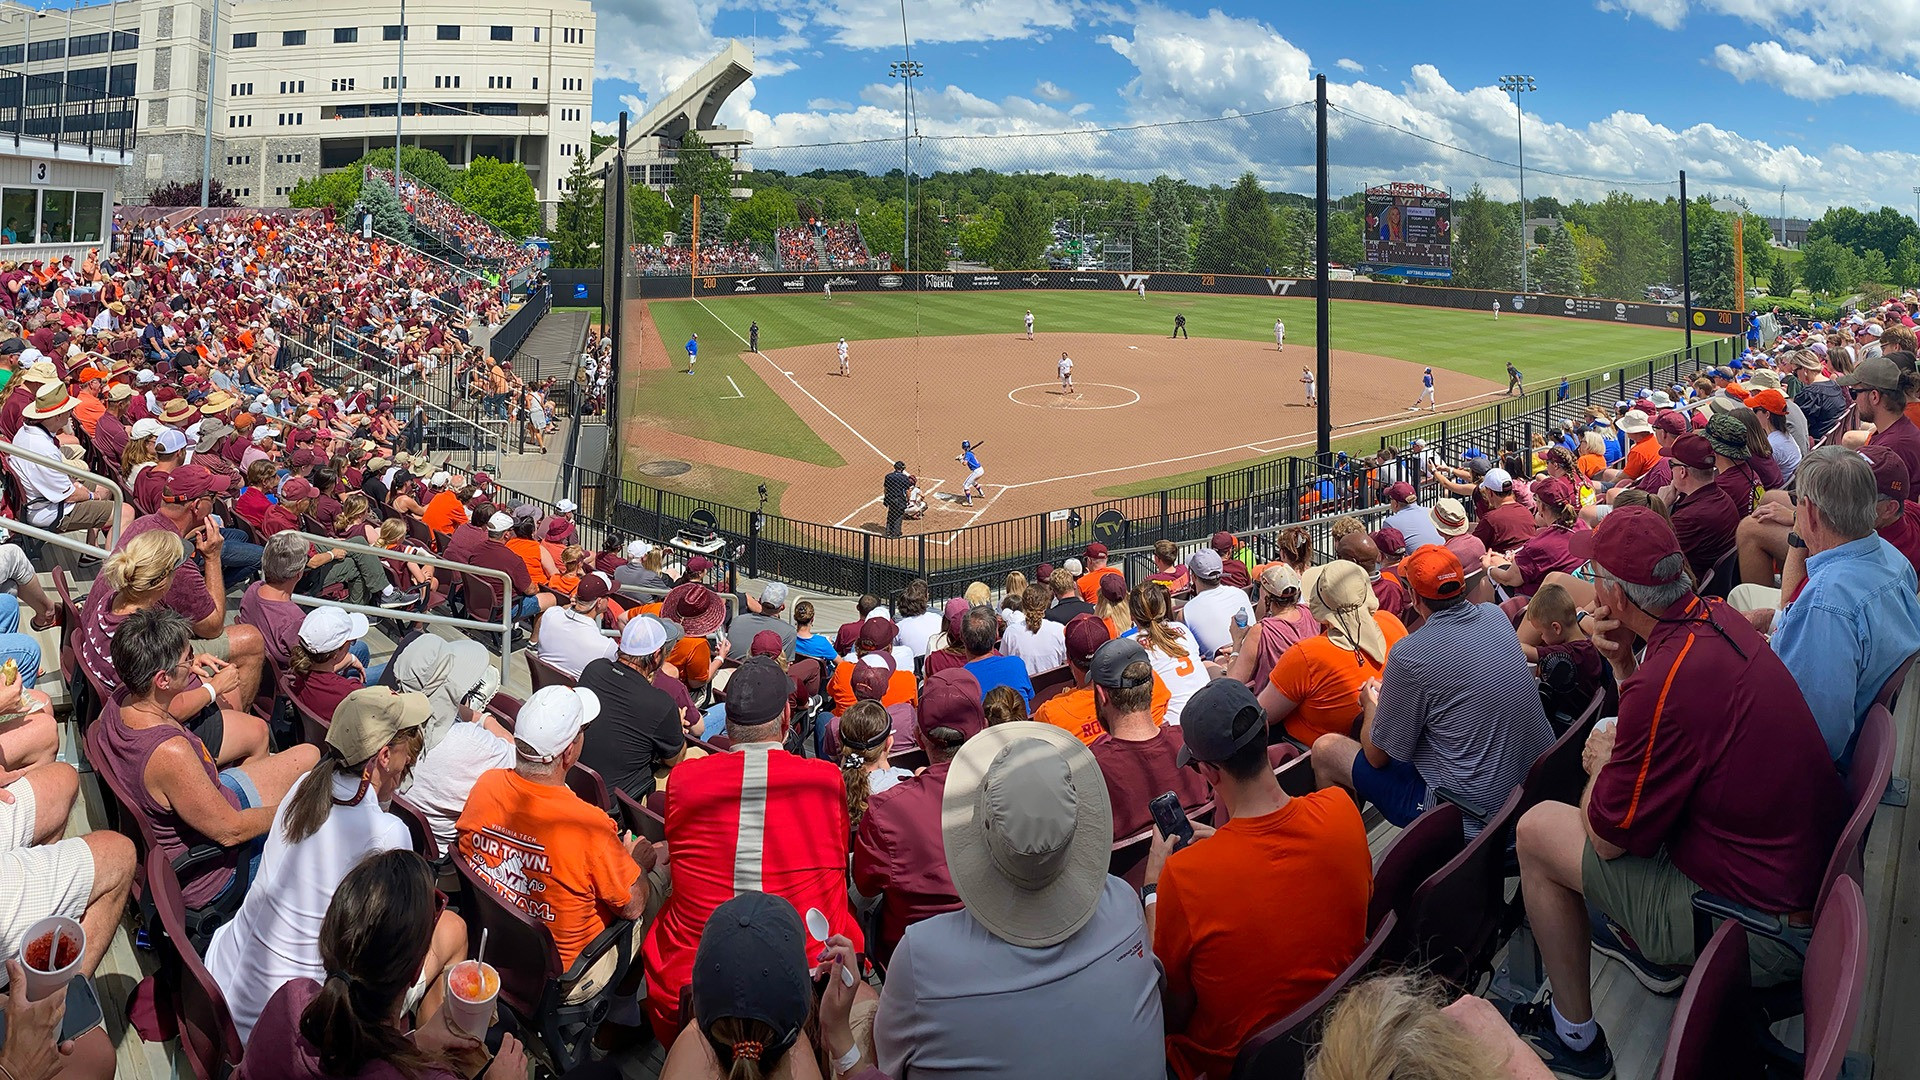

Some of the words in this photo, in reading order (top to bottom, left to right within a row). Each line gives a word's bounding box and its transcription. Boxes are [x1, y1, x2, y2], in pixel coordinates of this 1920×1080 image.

[37, 162, 47, 180] 3
[1391, 182, 1424, 191] TECH
[1400, 198, 1415, 206] VT
[703, 278, 717, 289] 200
[1118, 274, 1151, 290] VT
[1201, 275, 1215, 286] 220
[1266, 279, 1298, 295] VT
[1718, 312, 1732, 325] 200
[491, 824, 517, 838] VIRGINIA
[519, 833, 537, 843] TECH
[472, 832, 501, 859] OUR
